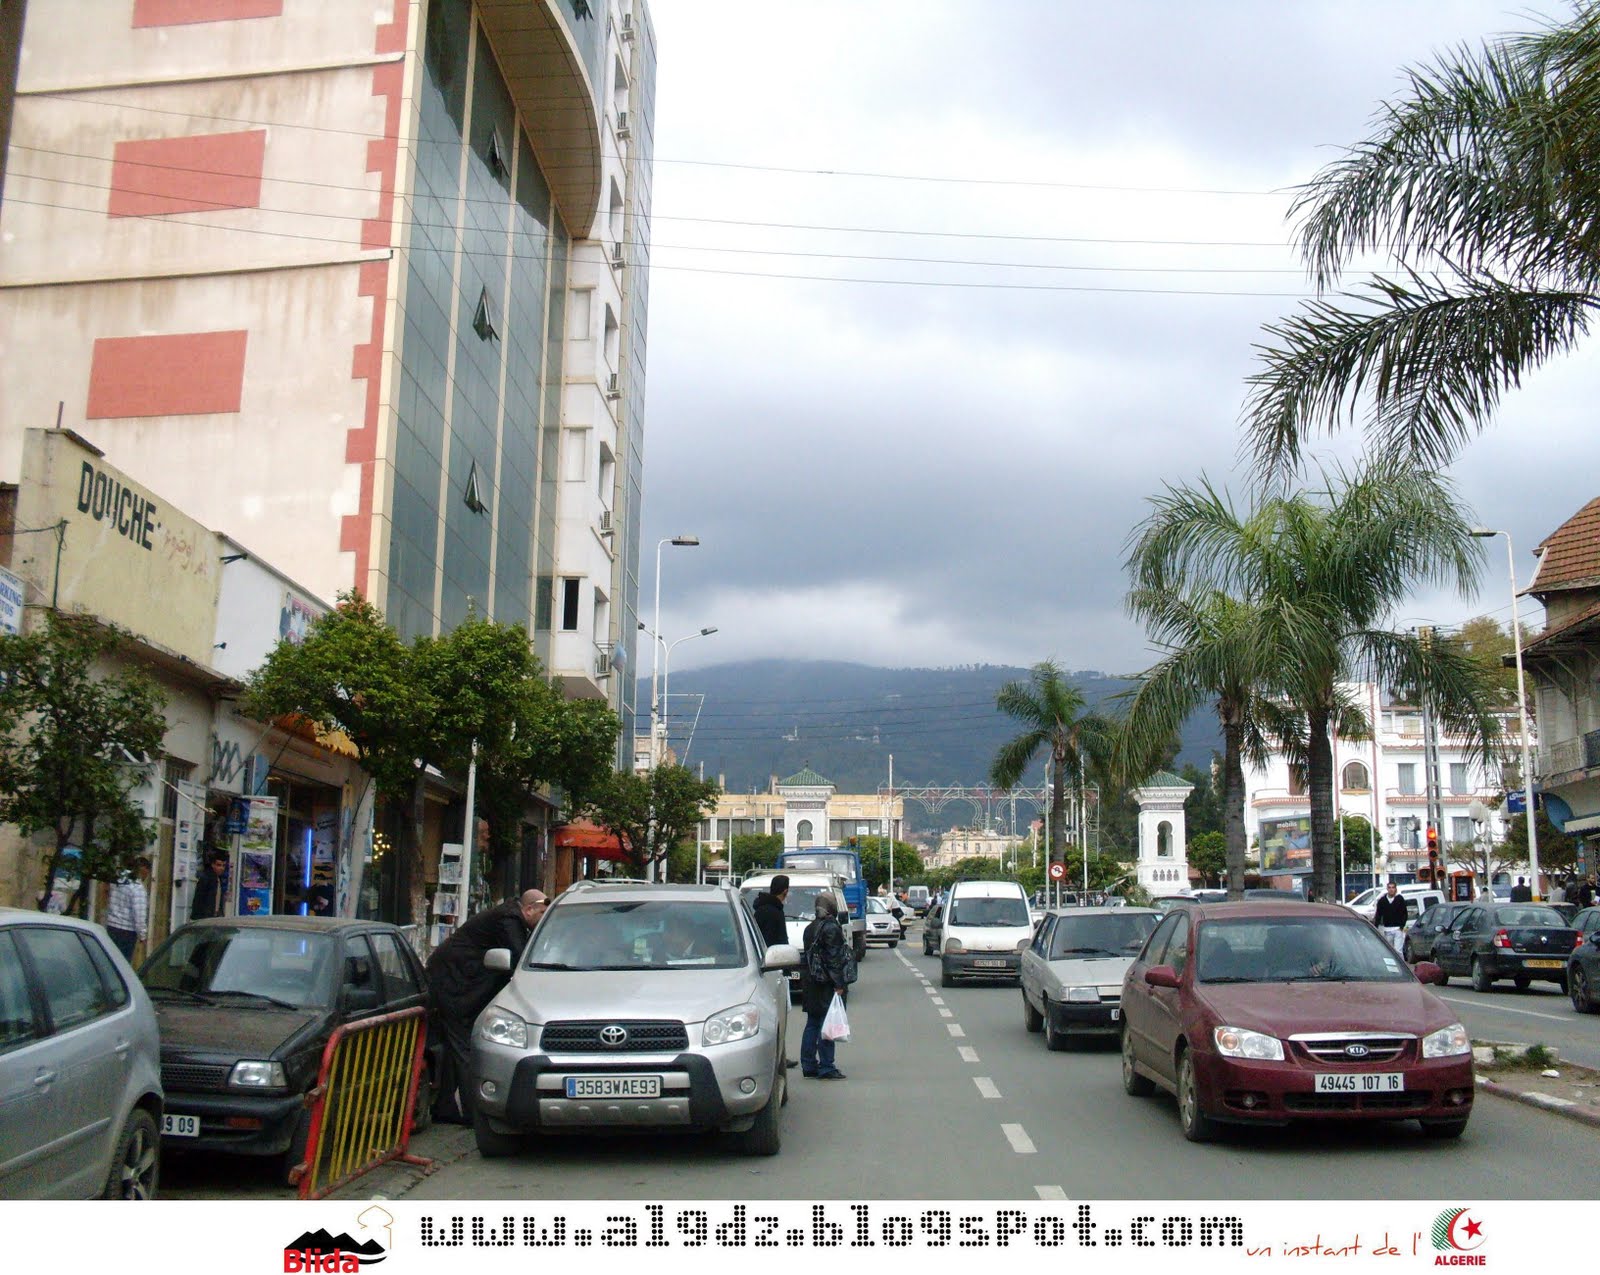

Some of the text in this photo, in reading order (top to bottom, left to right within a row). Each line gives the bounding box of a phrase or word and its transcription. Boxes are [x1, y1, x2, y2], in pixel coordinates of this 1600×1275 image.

[77, 460, 157, 551] DOUCHE
[576, 1080, 657, 1095] 3583WAE93
[1320, 1075, 1399, 1090] 49445 107 16
[179, 1117, 194, 1133] 09
